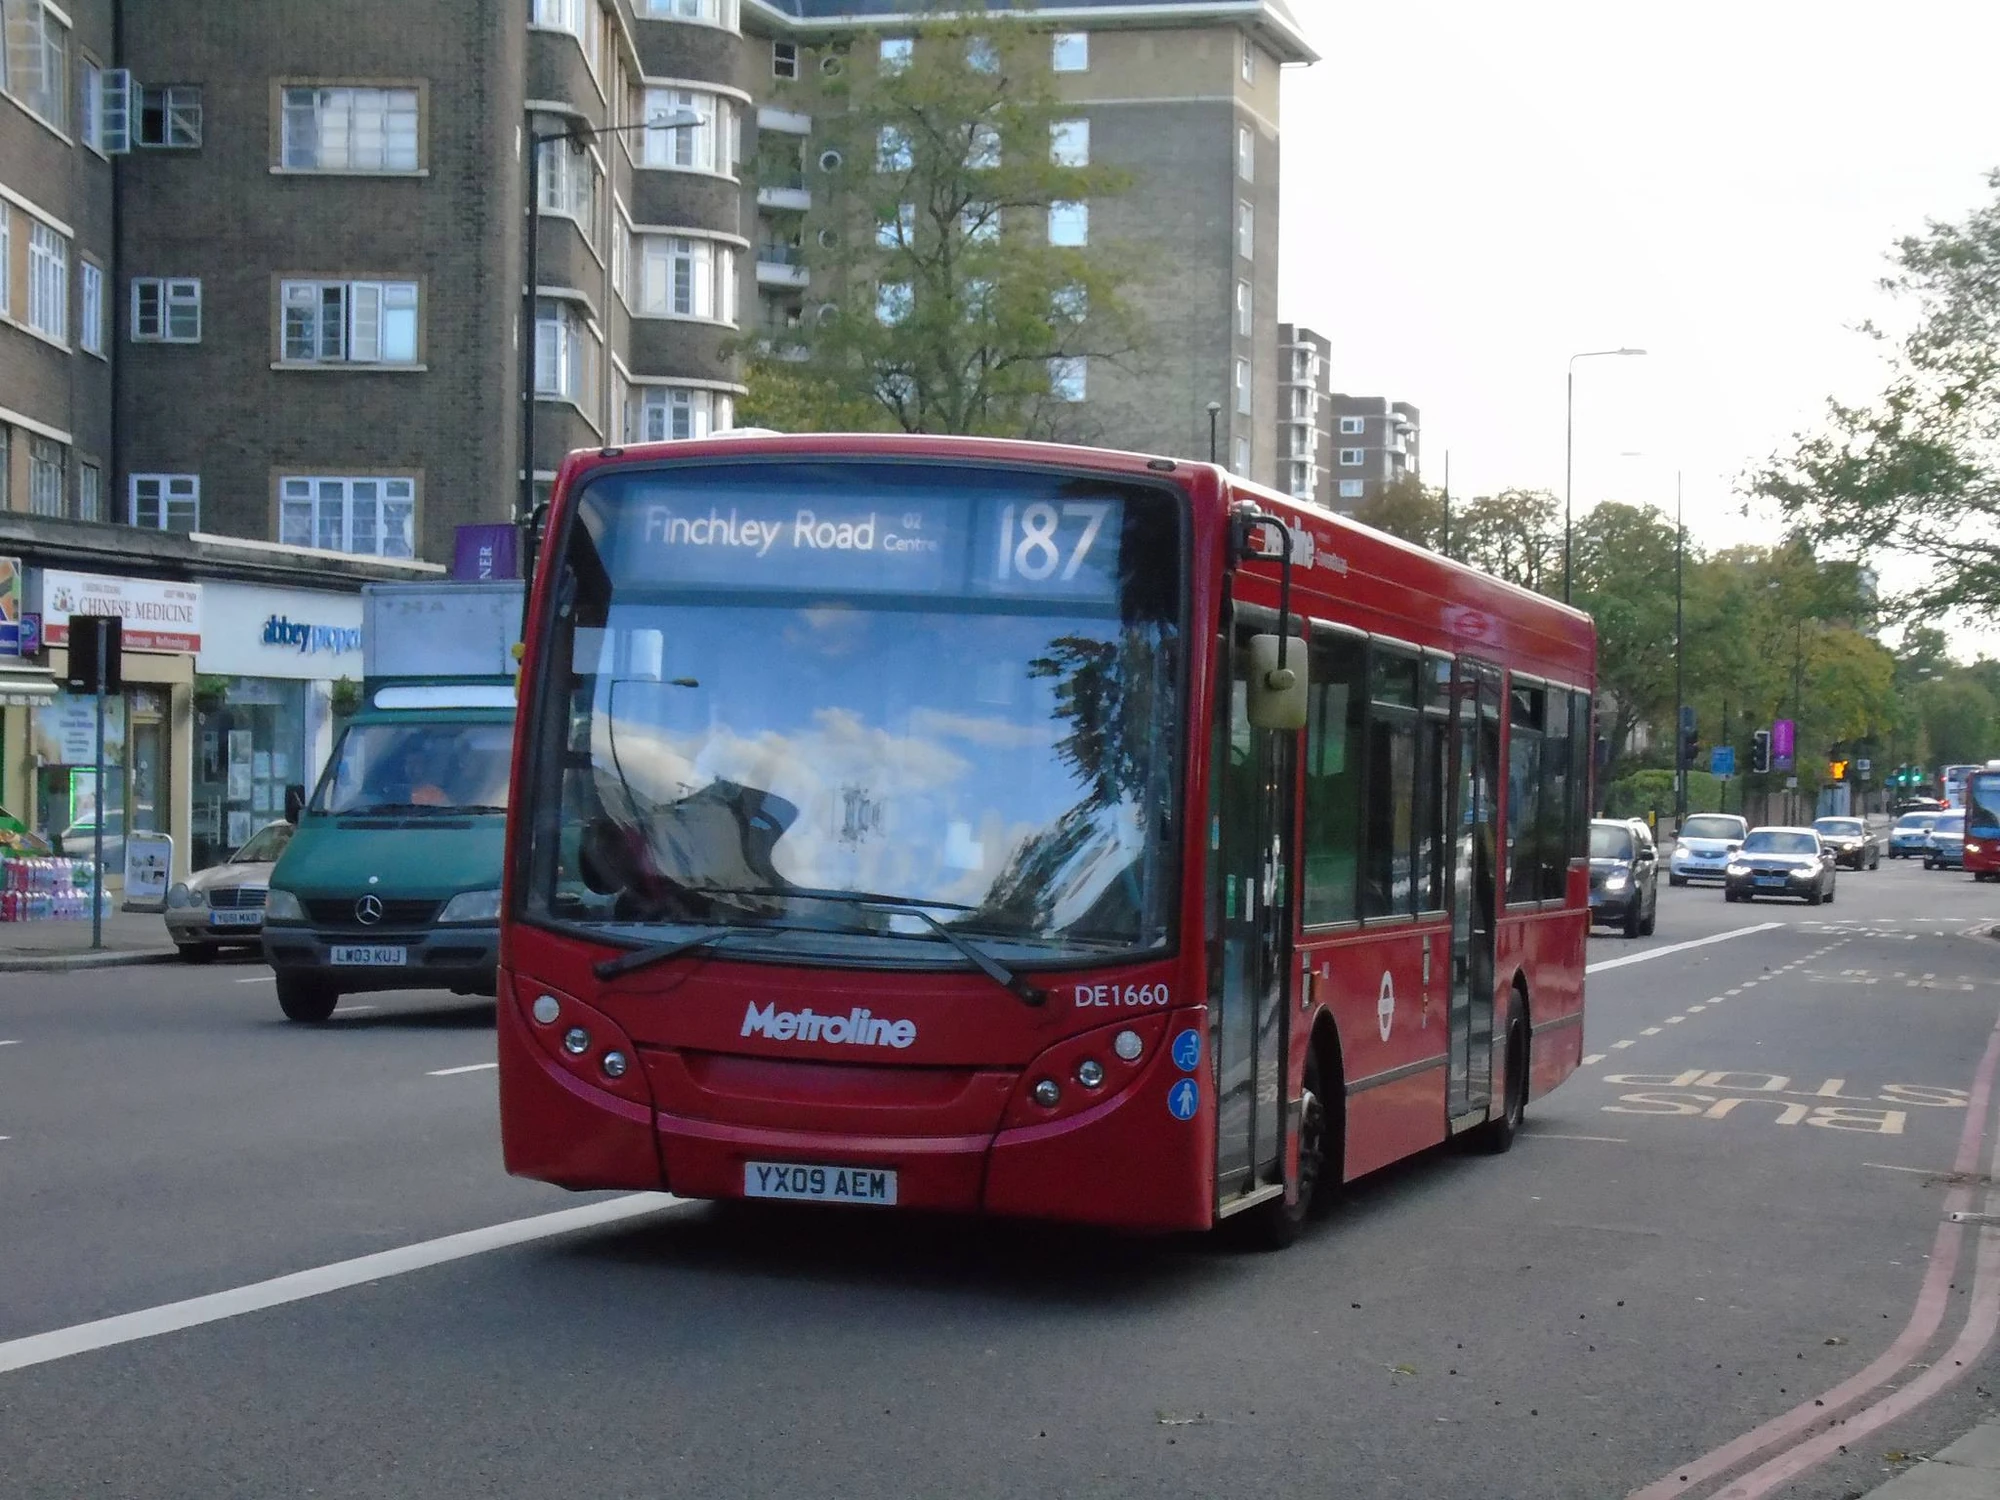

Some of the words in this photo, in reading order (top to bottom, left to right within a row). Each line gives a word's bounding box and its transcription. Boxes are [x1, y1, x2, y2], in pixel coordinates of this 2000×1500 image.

[645, 506, 782, 558] Finchley
[794, 510, 876, 551] Road
[883, 533, 938, 552] Centre
[998, 503, 1110, 580] 187
[79, 596, 131, 619] CHINESE
[138, 600, 194, 624] MEDICINE
[1075, 984, 1169, 1008] DE1660
[741, 1001, 917, 1048] Metroline
[1602, 1068, 1970, 1107] STOP
[1600, 1092, 1907, 1135] BUS
[757, 1166, 826, 1196] YX09
[833, 1170, 886, 1199] AEM
